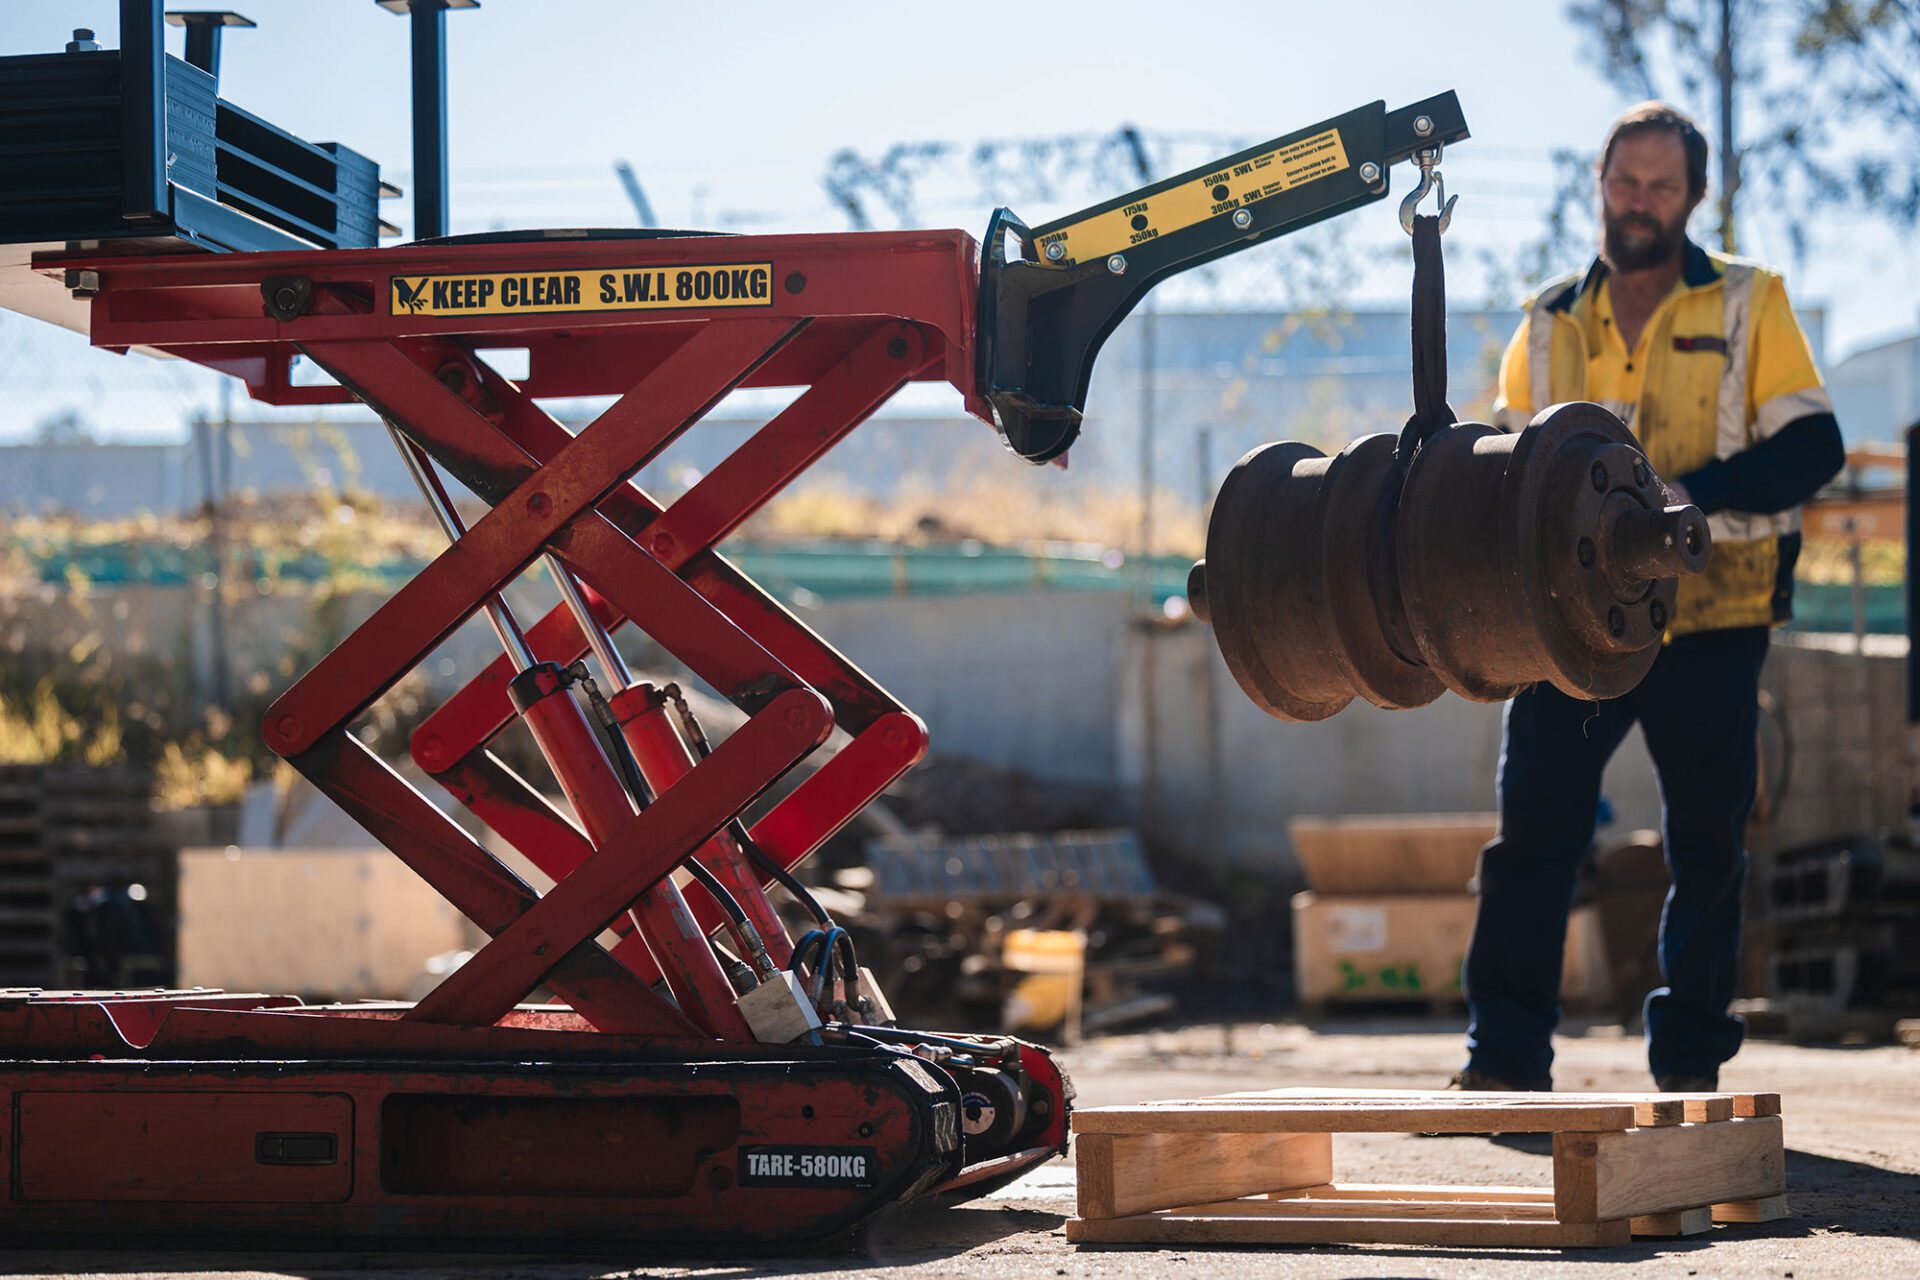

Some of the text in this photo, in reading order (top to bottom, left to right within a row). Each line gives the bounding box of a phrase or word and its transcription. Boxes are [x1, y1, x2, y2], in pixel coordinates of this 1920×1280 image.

[1305, 134, 1333, 146] accordance
[1294, 148, 1317, 160] Operator's
[1203, 163, 1253, 188] 150kg SWL
[1286, 168, 1302, 177] Ensure
[1122, 202, 1148, 217] 175kg
[1211, 189, 1263, 215] 300kg SWL
[1129, 228, 1159, 244] 350kg
[432, 269, 767, 309] KEEP CLEAR S.W.L 800KG
[747, 1154, 866, 1178] TARE-580KG
